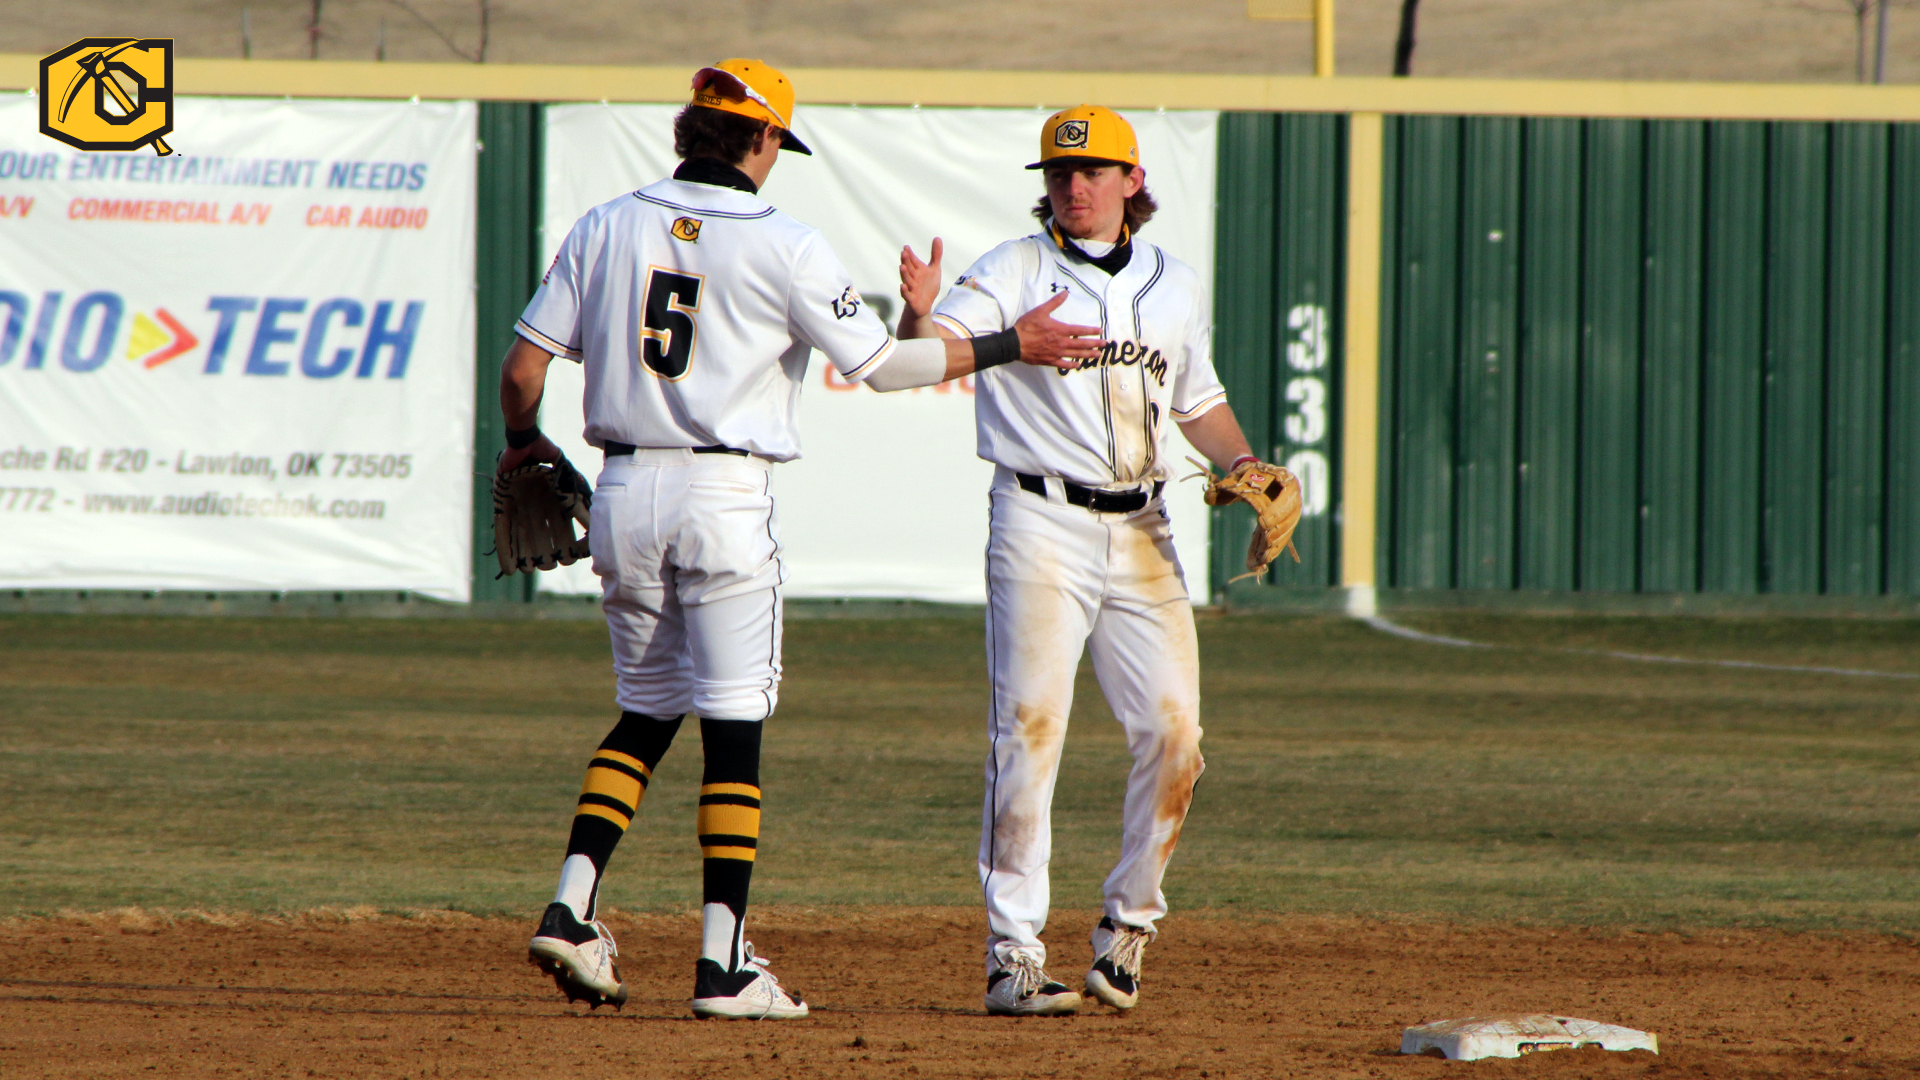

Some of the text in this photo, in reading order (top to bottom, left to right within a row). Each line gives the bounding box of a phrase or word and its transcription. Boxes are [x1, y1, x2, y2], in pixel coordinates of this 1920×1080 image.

[0, 152, 429, 192] OUR ENTERTAINMENT NEEDS
[68, 198, 272, 226] COMMERCIAL A/V
[305, 205, 429, 230] CAR AUDIO
[203, 296, 424, 379] TECH
[639, 264, 706, 383] 5
[1057, 335, 1168, 387] meron
[1286, 305, 1329, 516] 330
[54, 447, 90, 472] Rd
[98, 448, 150, 473] #20
[174, 452, 277, 481] Lawton,
[286, 453, 323, 477] OK
[331, 454, 413, 478] 73505
[84, 492, 387, 520] www.audiotechok.com
